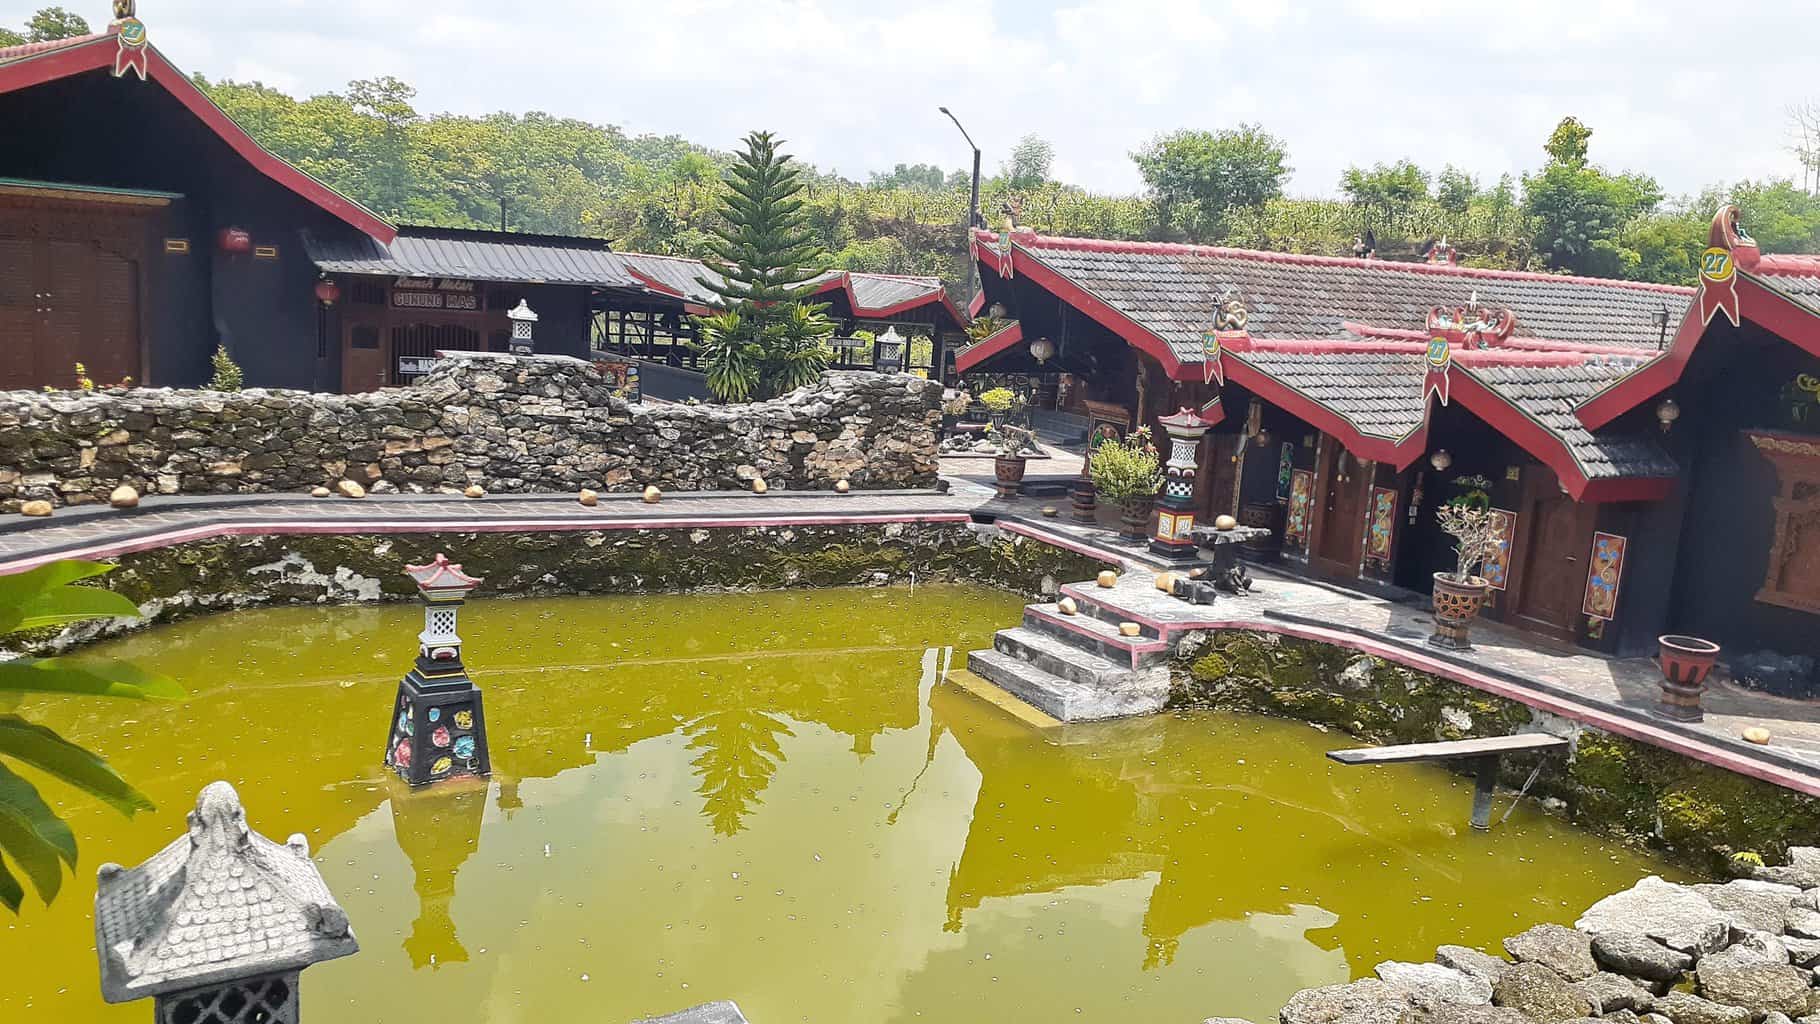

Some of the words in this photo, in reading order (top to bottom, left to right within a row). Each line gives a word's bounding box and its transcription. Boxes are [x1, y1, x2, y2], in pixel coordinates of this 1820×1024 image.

[1703, 253, 1728, 274] 27
[394, 292, 442, 308] GUNUNG
[446, 294, 477, 310] MAS
[1430, 341, 1447, 360] 27
